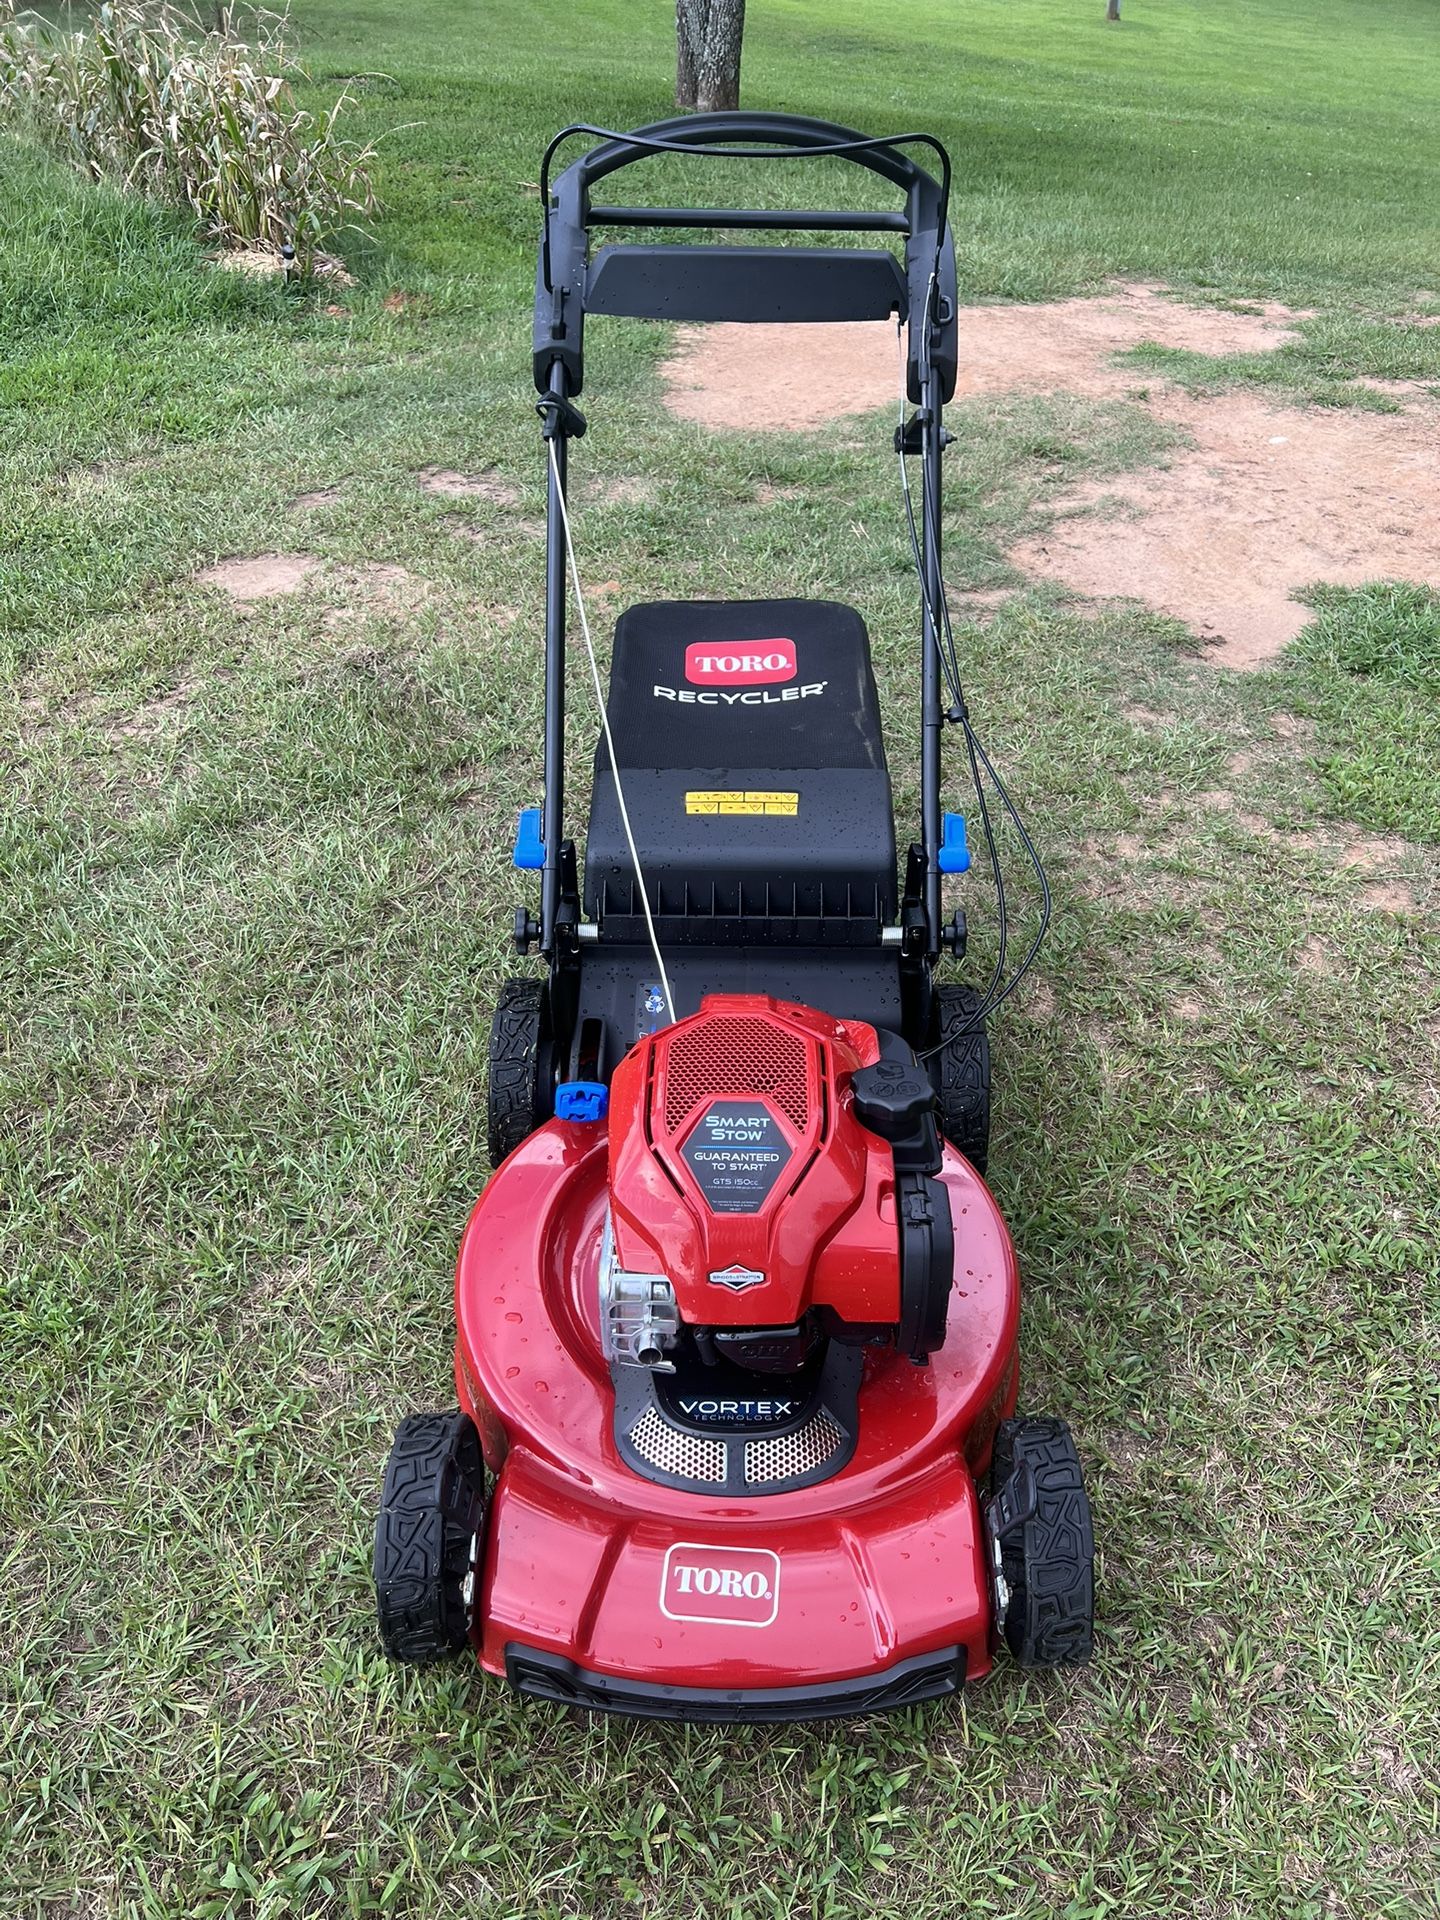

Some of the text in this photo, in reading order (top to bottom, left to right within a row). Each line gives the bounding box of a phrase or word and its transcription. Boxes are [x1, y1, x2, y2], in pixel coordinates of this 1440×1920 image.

[695, 653, 788, 673] TORO
[653, 682, 825, 705] RECYCLER
[694, 1152, 780, 1162] GUARANTEED
[711, 1162, 726, 1171] TO
[679, 1401, 791, 1414] VORTEX
[674, 1566, 769, 1599] TORO
